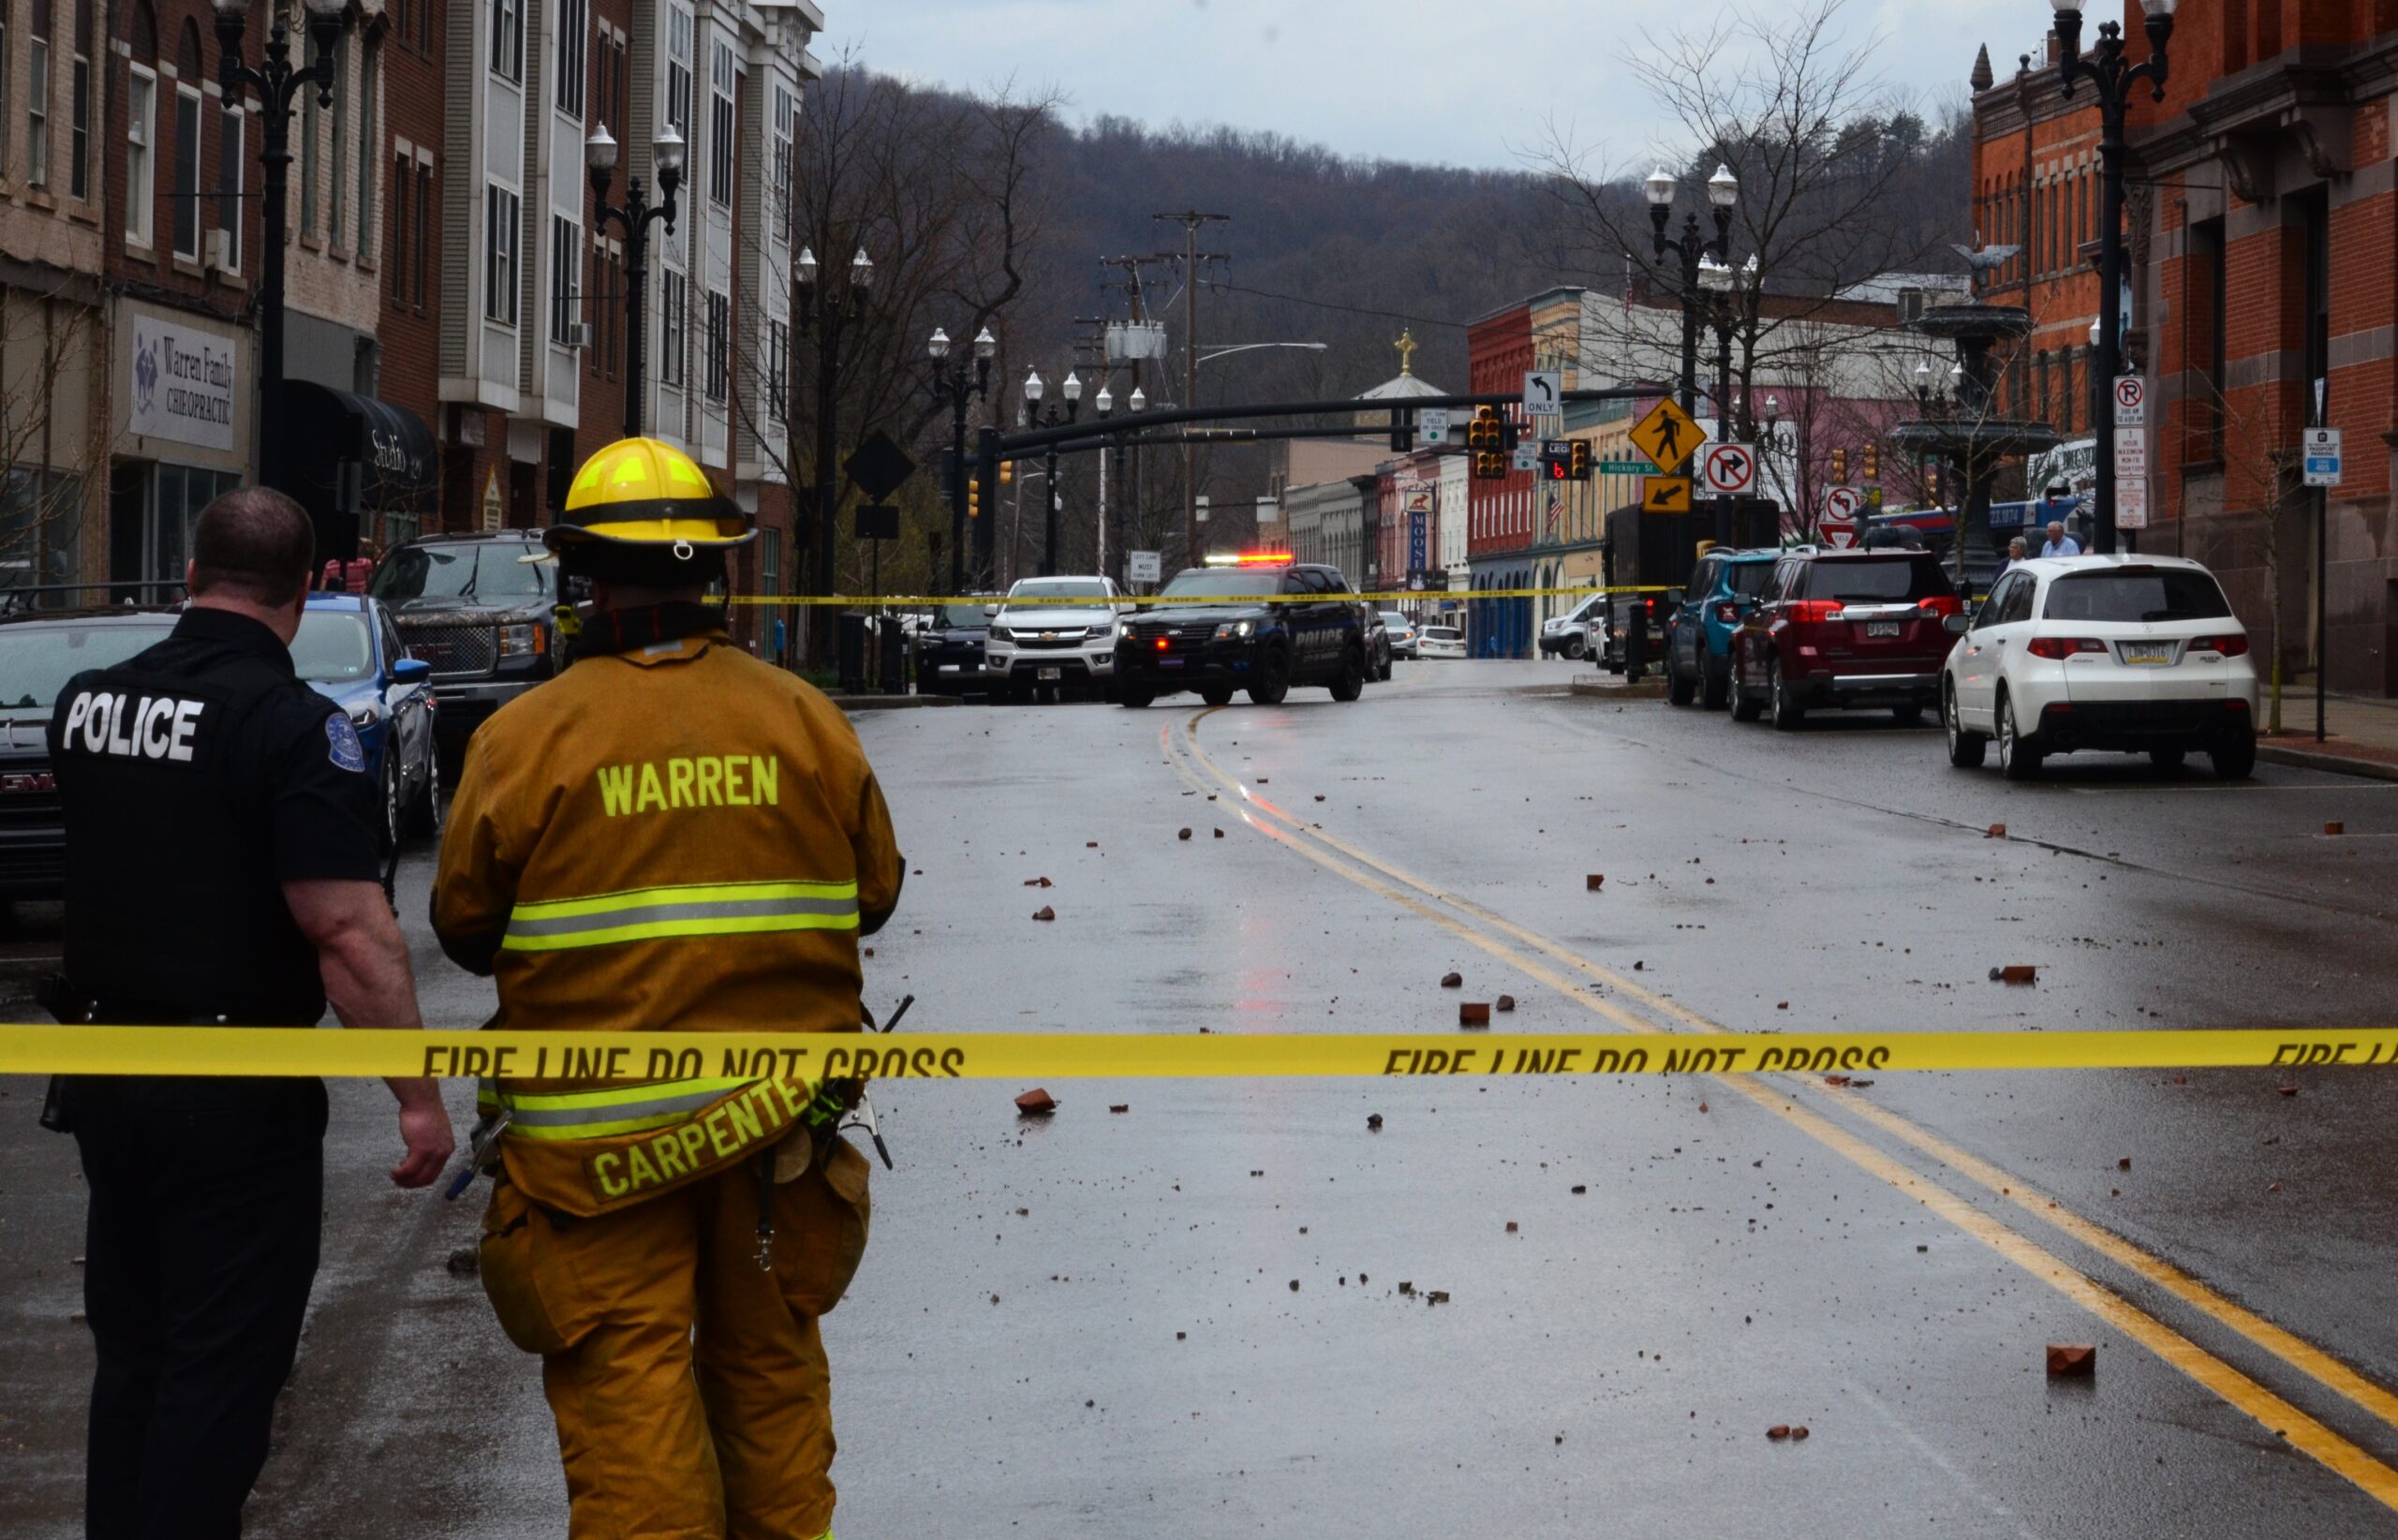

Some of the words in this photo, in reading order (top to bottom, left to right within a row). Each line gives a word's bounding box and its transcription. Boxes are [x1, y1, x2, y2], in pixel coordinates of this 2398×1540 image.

[164, 335, 200, 380] Warren
[204, 346, 232, 397] Family
[1528, 403, 1554, 412] ONLY
[372, 429, 407, 473] Studio
[1608, 464, 1640, 473] Hickory
[1644, 464, 1654, 472] St
[1414, 515, 1425, 570] MOOSE
[1295, 627, 1344, 648] POLICE
[63, 691, 205, 762] POLICE
[597, 755, 778, 817] WARREN
